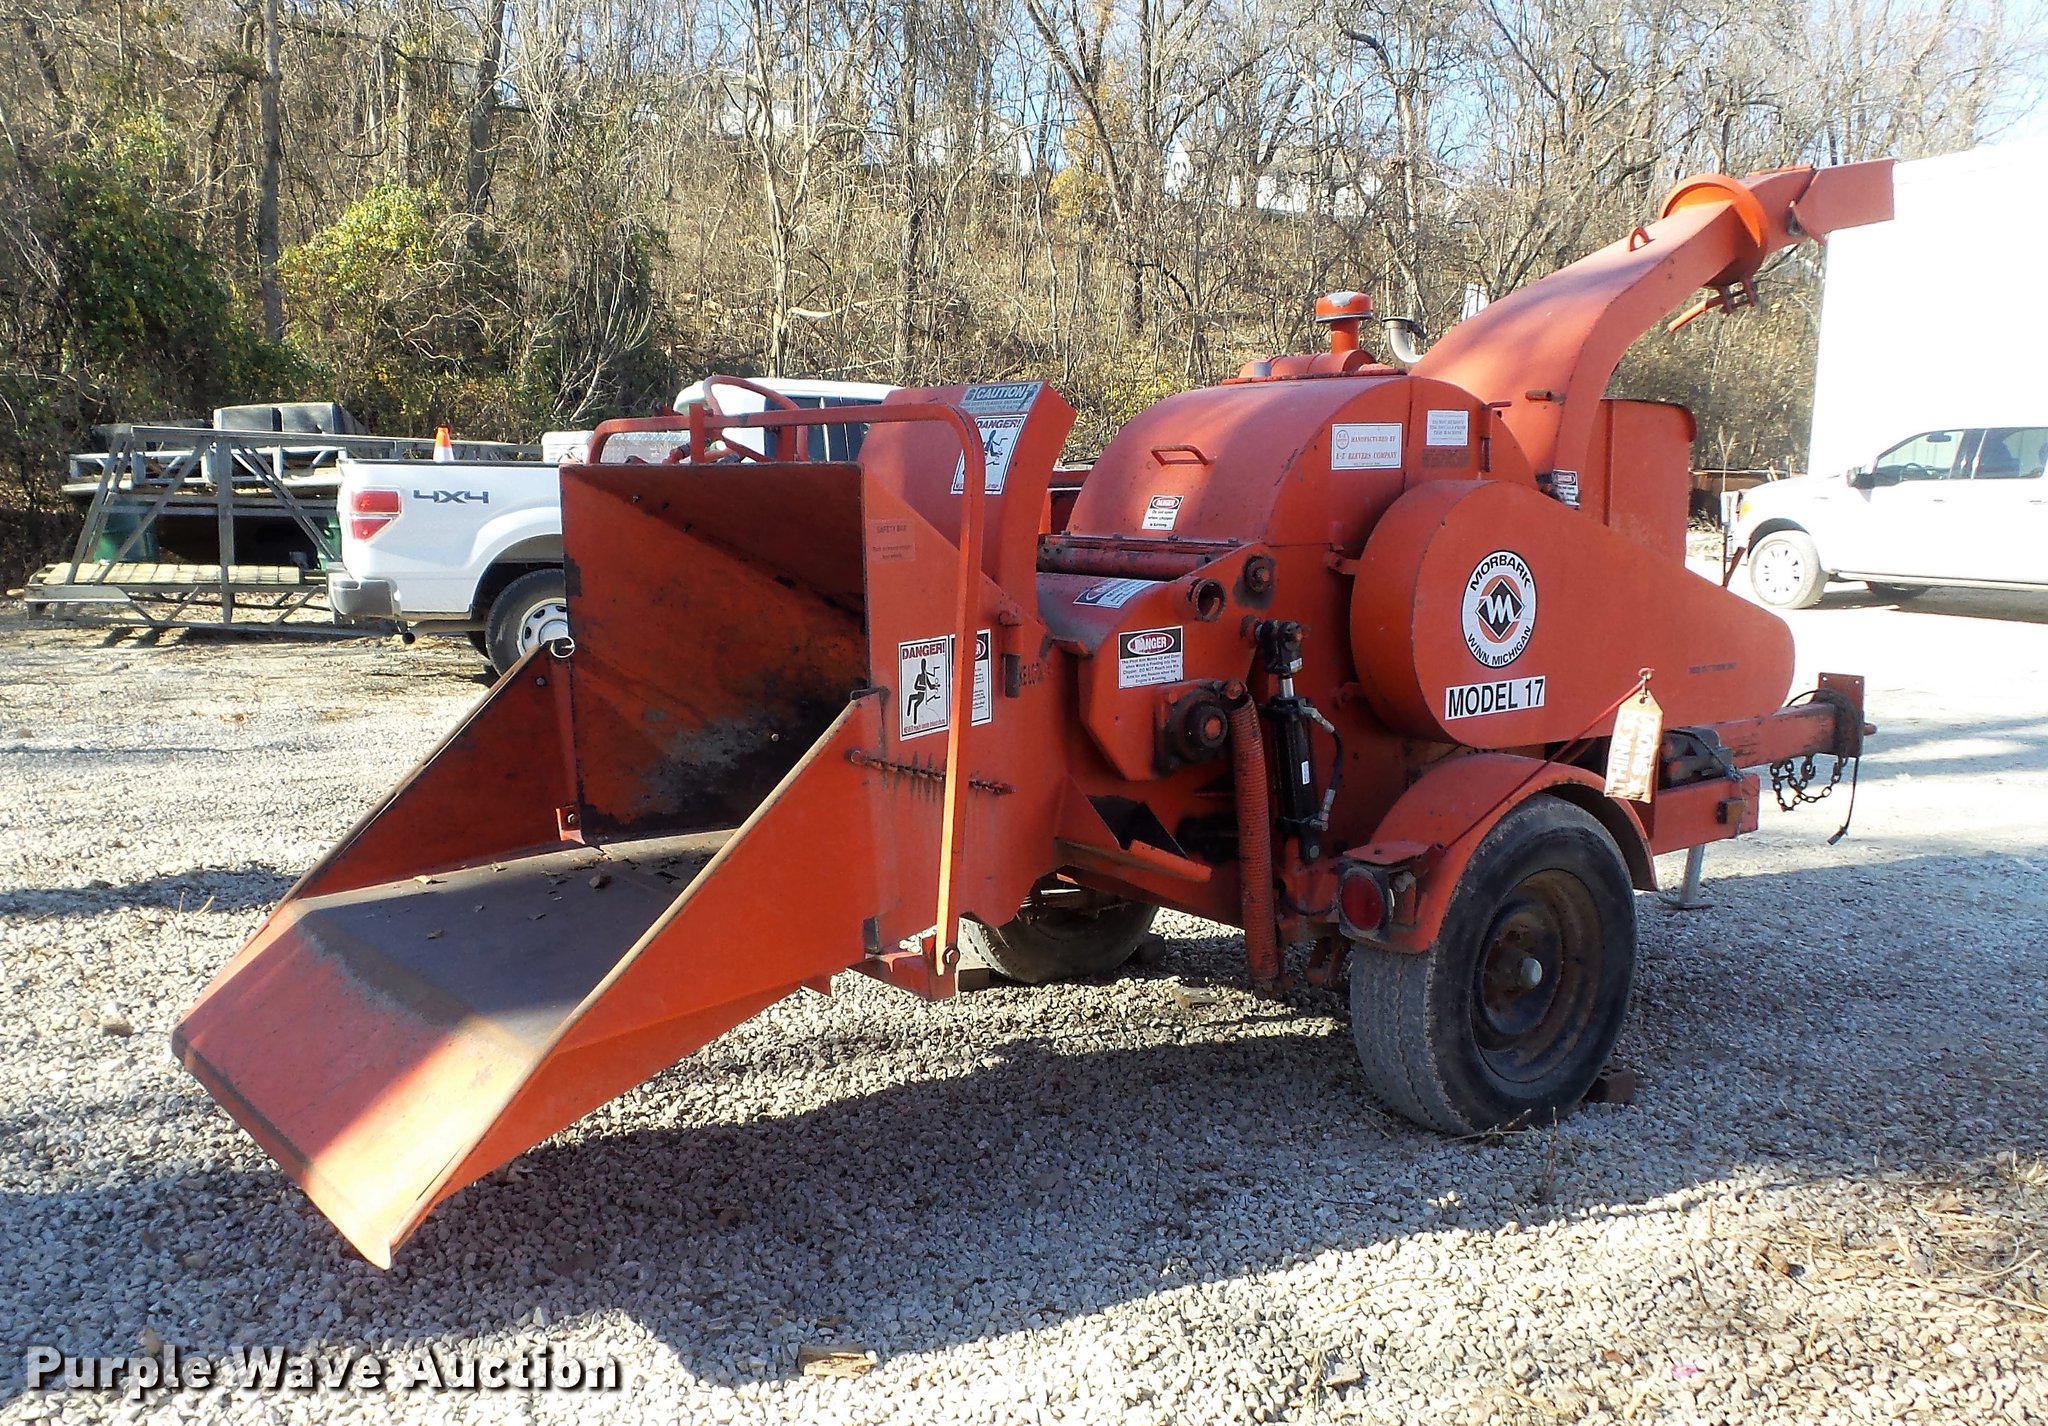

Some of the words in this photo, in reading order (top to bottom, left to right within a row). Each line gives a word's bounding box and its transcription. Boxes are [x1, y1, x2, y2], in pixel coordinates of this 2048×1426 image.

[976, 386, 1026, 399] CAUTION
[1470, 555, 1532, 592] MORBARK
[902, 642, 945, 660] DANGER!
[1492, 626, 1531, 666] MICHIGAN
[1448, 682, 1517, 717] MODEL
[1525, 678, 1544, 706] 17
